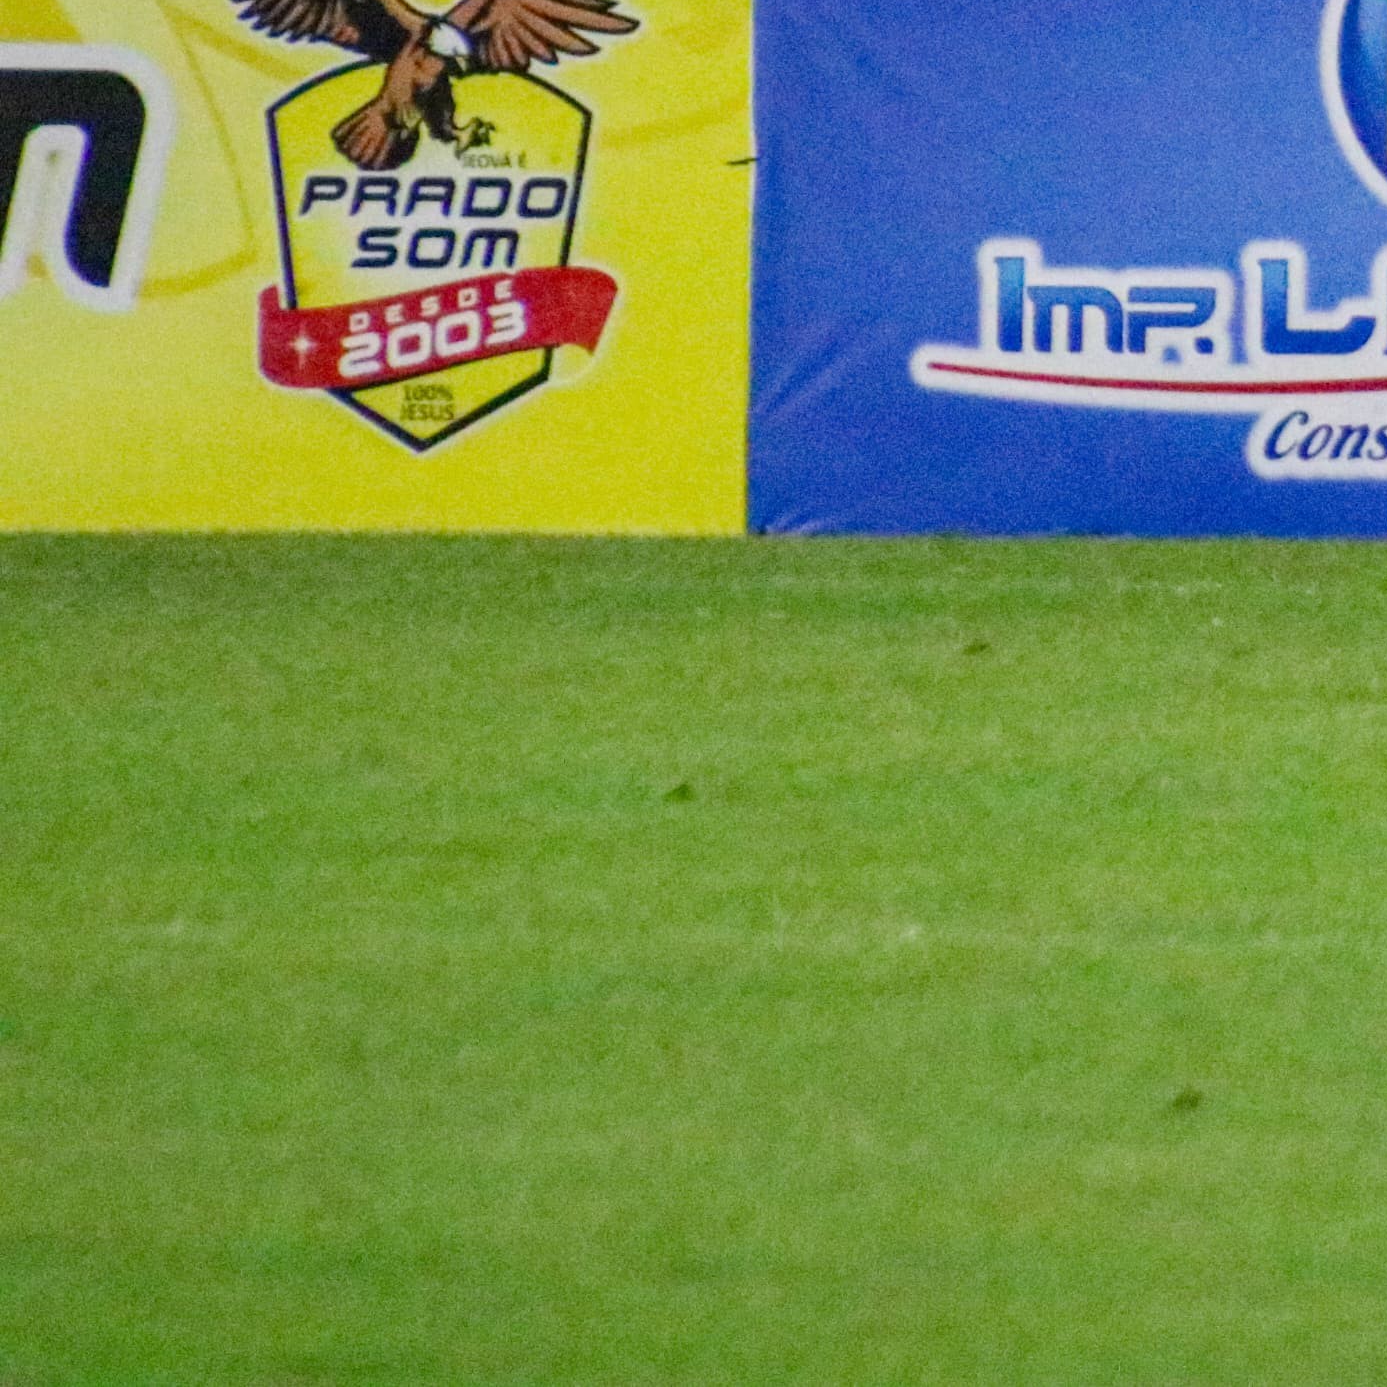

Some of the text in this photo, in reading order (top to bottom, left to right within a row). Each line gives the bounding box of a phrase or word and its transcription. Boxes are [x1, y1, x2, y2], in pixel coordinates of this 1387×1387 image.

[299, 176, 568, 217] PRADO
[350, 227, 521, 269] SOM
[348, 278, 514, 334] DESDE
[337, 300, 527, 379] 2003
[401, 403, 455, 422] JESUS
